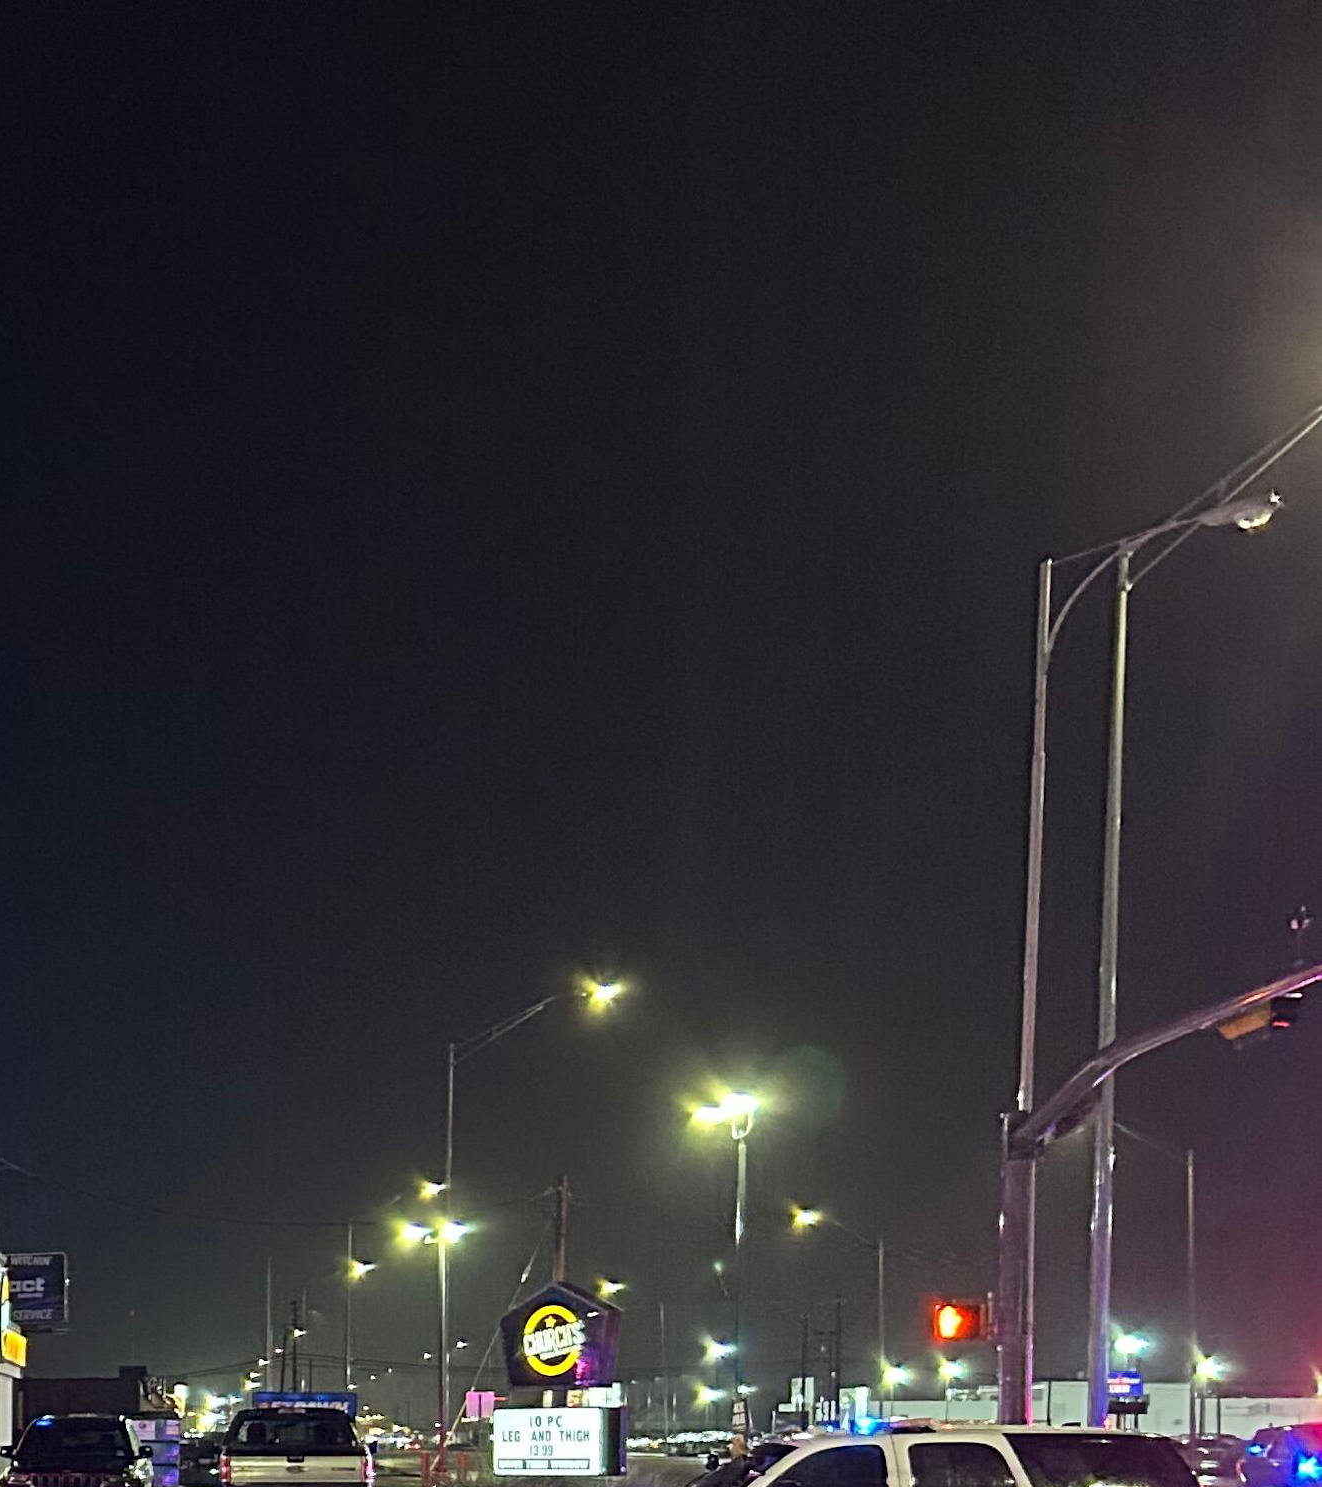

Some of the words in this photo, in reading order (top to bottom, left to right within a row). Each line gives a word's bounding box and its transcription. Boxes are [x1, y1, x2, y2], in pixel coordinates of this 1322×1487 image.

[529, 1415, 542, 1428] 10
[547, 1415, 563, 1428] PC
[502, 1430, 521, 1443] LEG
[531, 1430, 552, 1443] AND
[559, 1430, 590, 1443] THIGH
